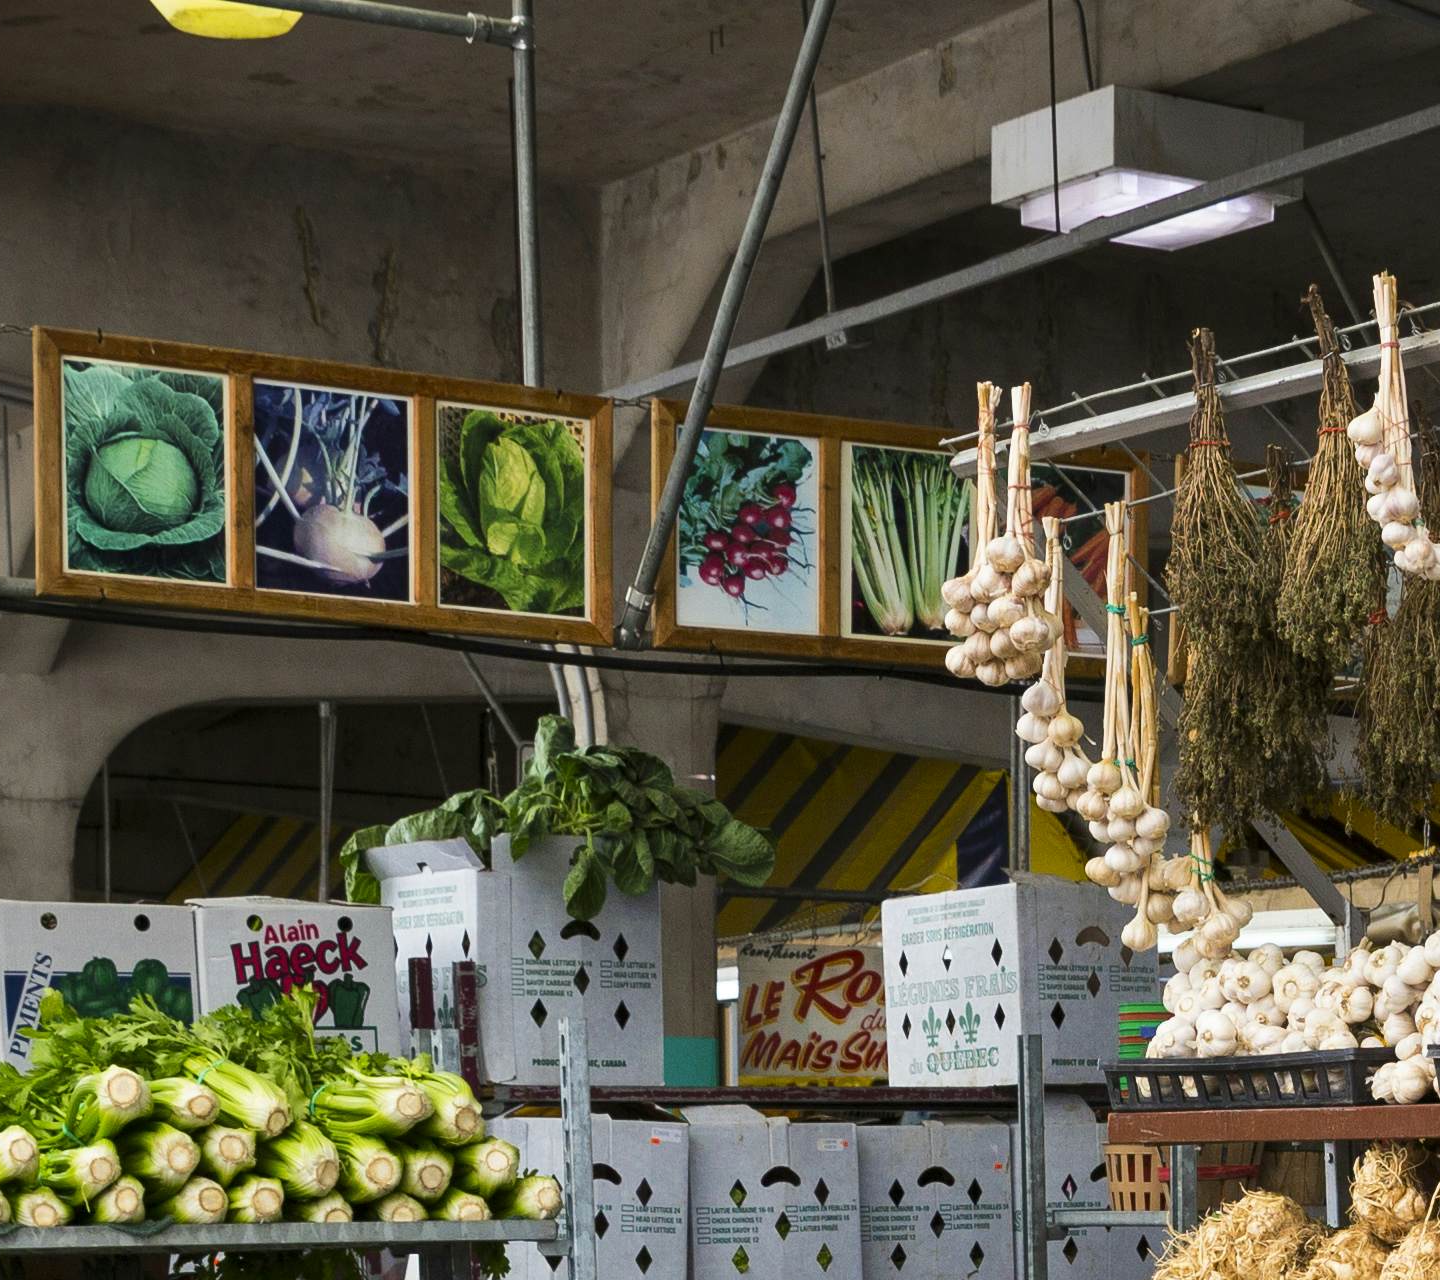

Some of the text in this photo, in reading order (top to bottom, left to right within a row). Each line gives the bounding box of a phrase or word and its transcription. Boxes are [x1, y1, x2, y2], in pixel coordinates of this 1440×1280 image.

[264, 919, 320, 945] Alain
[926, 927, 943, 944] SOUS
[230, 931, 368, 985] Haeck
[10, 952, 53, 1059] PIMENTS
[742, 981, 786, 1034] LE
[910, 1041, 1000, 1076] du QUÉBEC
